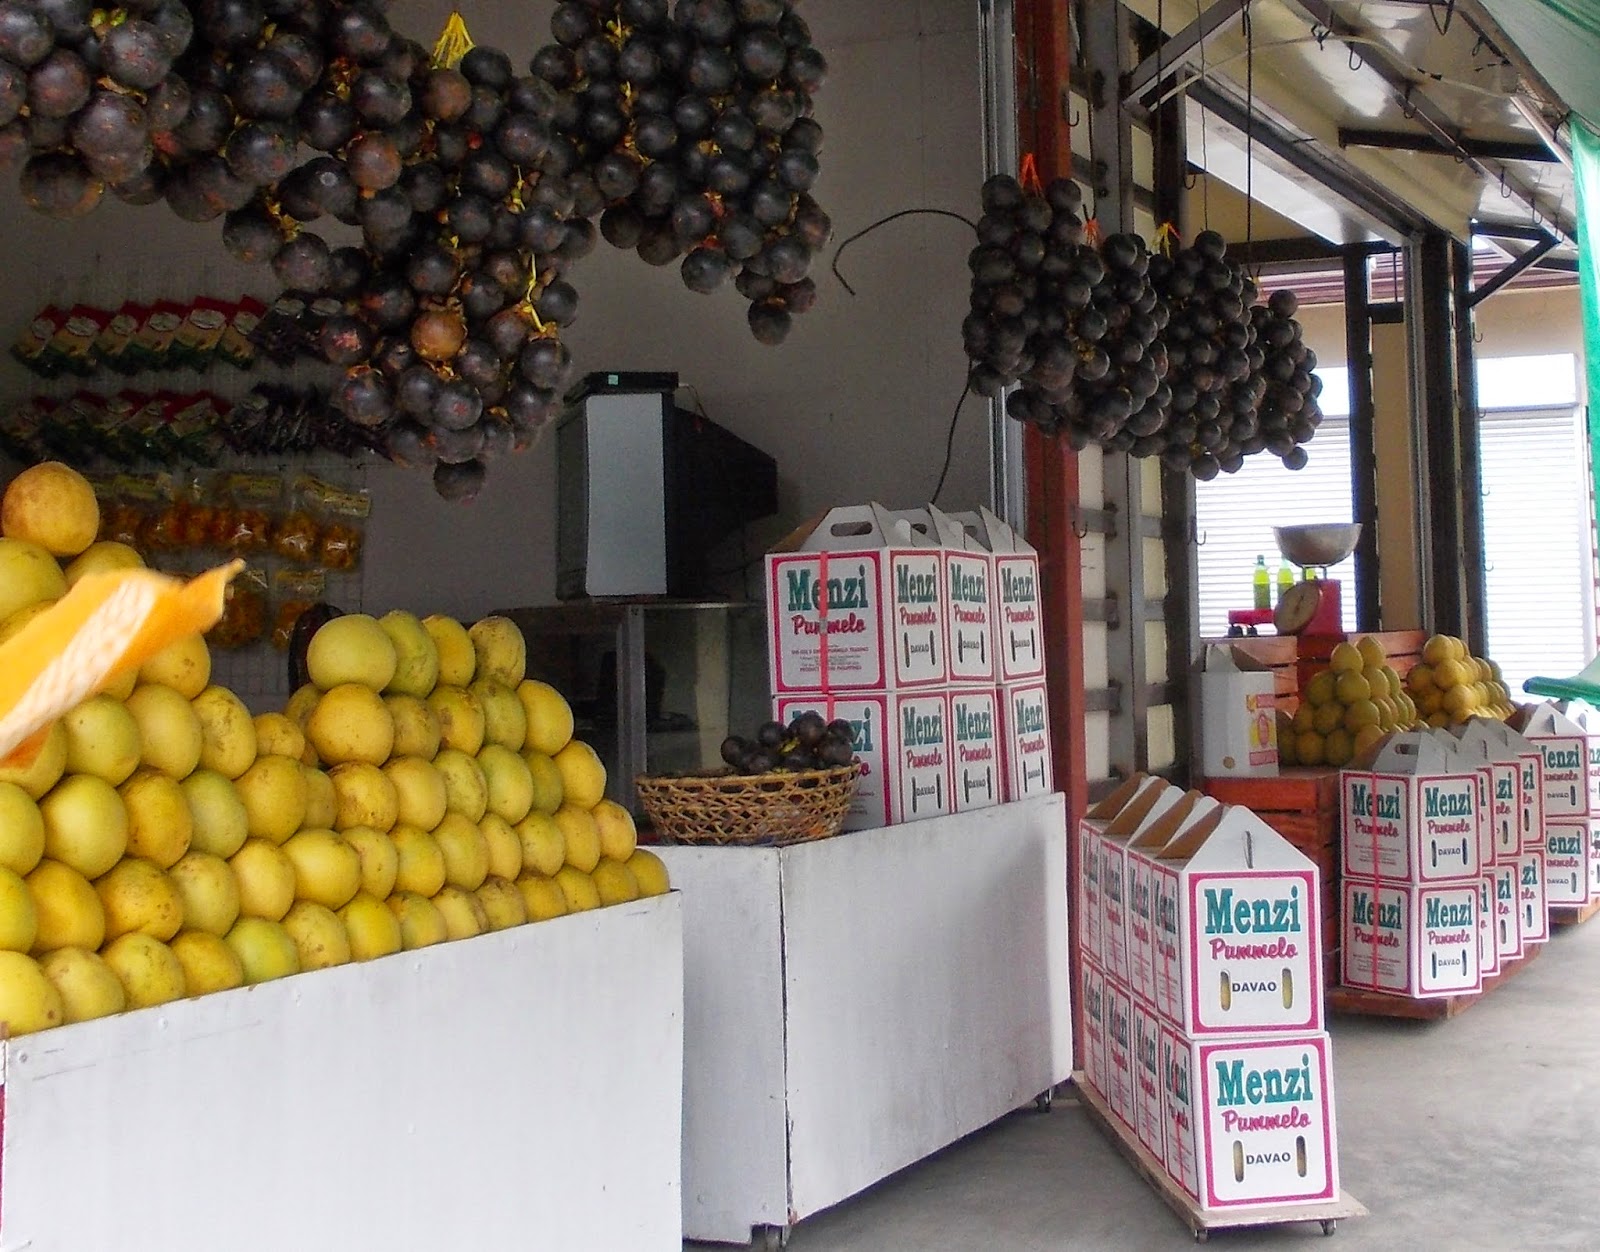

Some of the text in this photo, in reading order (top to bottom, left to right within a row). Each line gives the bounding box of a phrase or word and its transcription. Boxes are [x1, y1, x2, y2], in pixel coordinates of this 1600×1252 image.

[787, 564, 868, 611] Menzi
[897, 563, 938, 603] Menzi
[951, 563, 986, 603] Menzi
[1001, 566, 1035, 603] Menzi
[903, 703, 943, 746] Menzi
[956, 701, 992, 740] Menzi
[1016, 692, 1045, 735] Menzi
[1544, 770, 1579, 781] ummelo
[1352, 783, 1400, 819] Menzi
[1425, 784, 1472, 817] Menzi
[1427, 819, 1471, 835] Pummelo
[1546, 830, 1582, 854] enzi
[1438, 848, 1460, 856] DAVAO
[1547, 856, 1579, 867] ummelo
[1204, 885, 1301, 934] Menzi
[1353, 892, 1402, 929] Menzi
[1426, 894, 1473, 928] Menzi
[1209, 936, 1298, 960] Pummelo
[1427, 929, 1471, 945] Pummelo
[1438, 958, 1460, 967] DAVAO
[1232, 981, 1277, 992] DAVAO
[1215, 1053, 1313, 1106] Menzi
[1221, 1106, 1311, 1133] Pummelo
[1246, 1152, 1291, 1164] DAVAO
